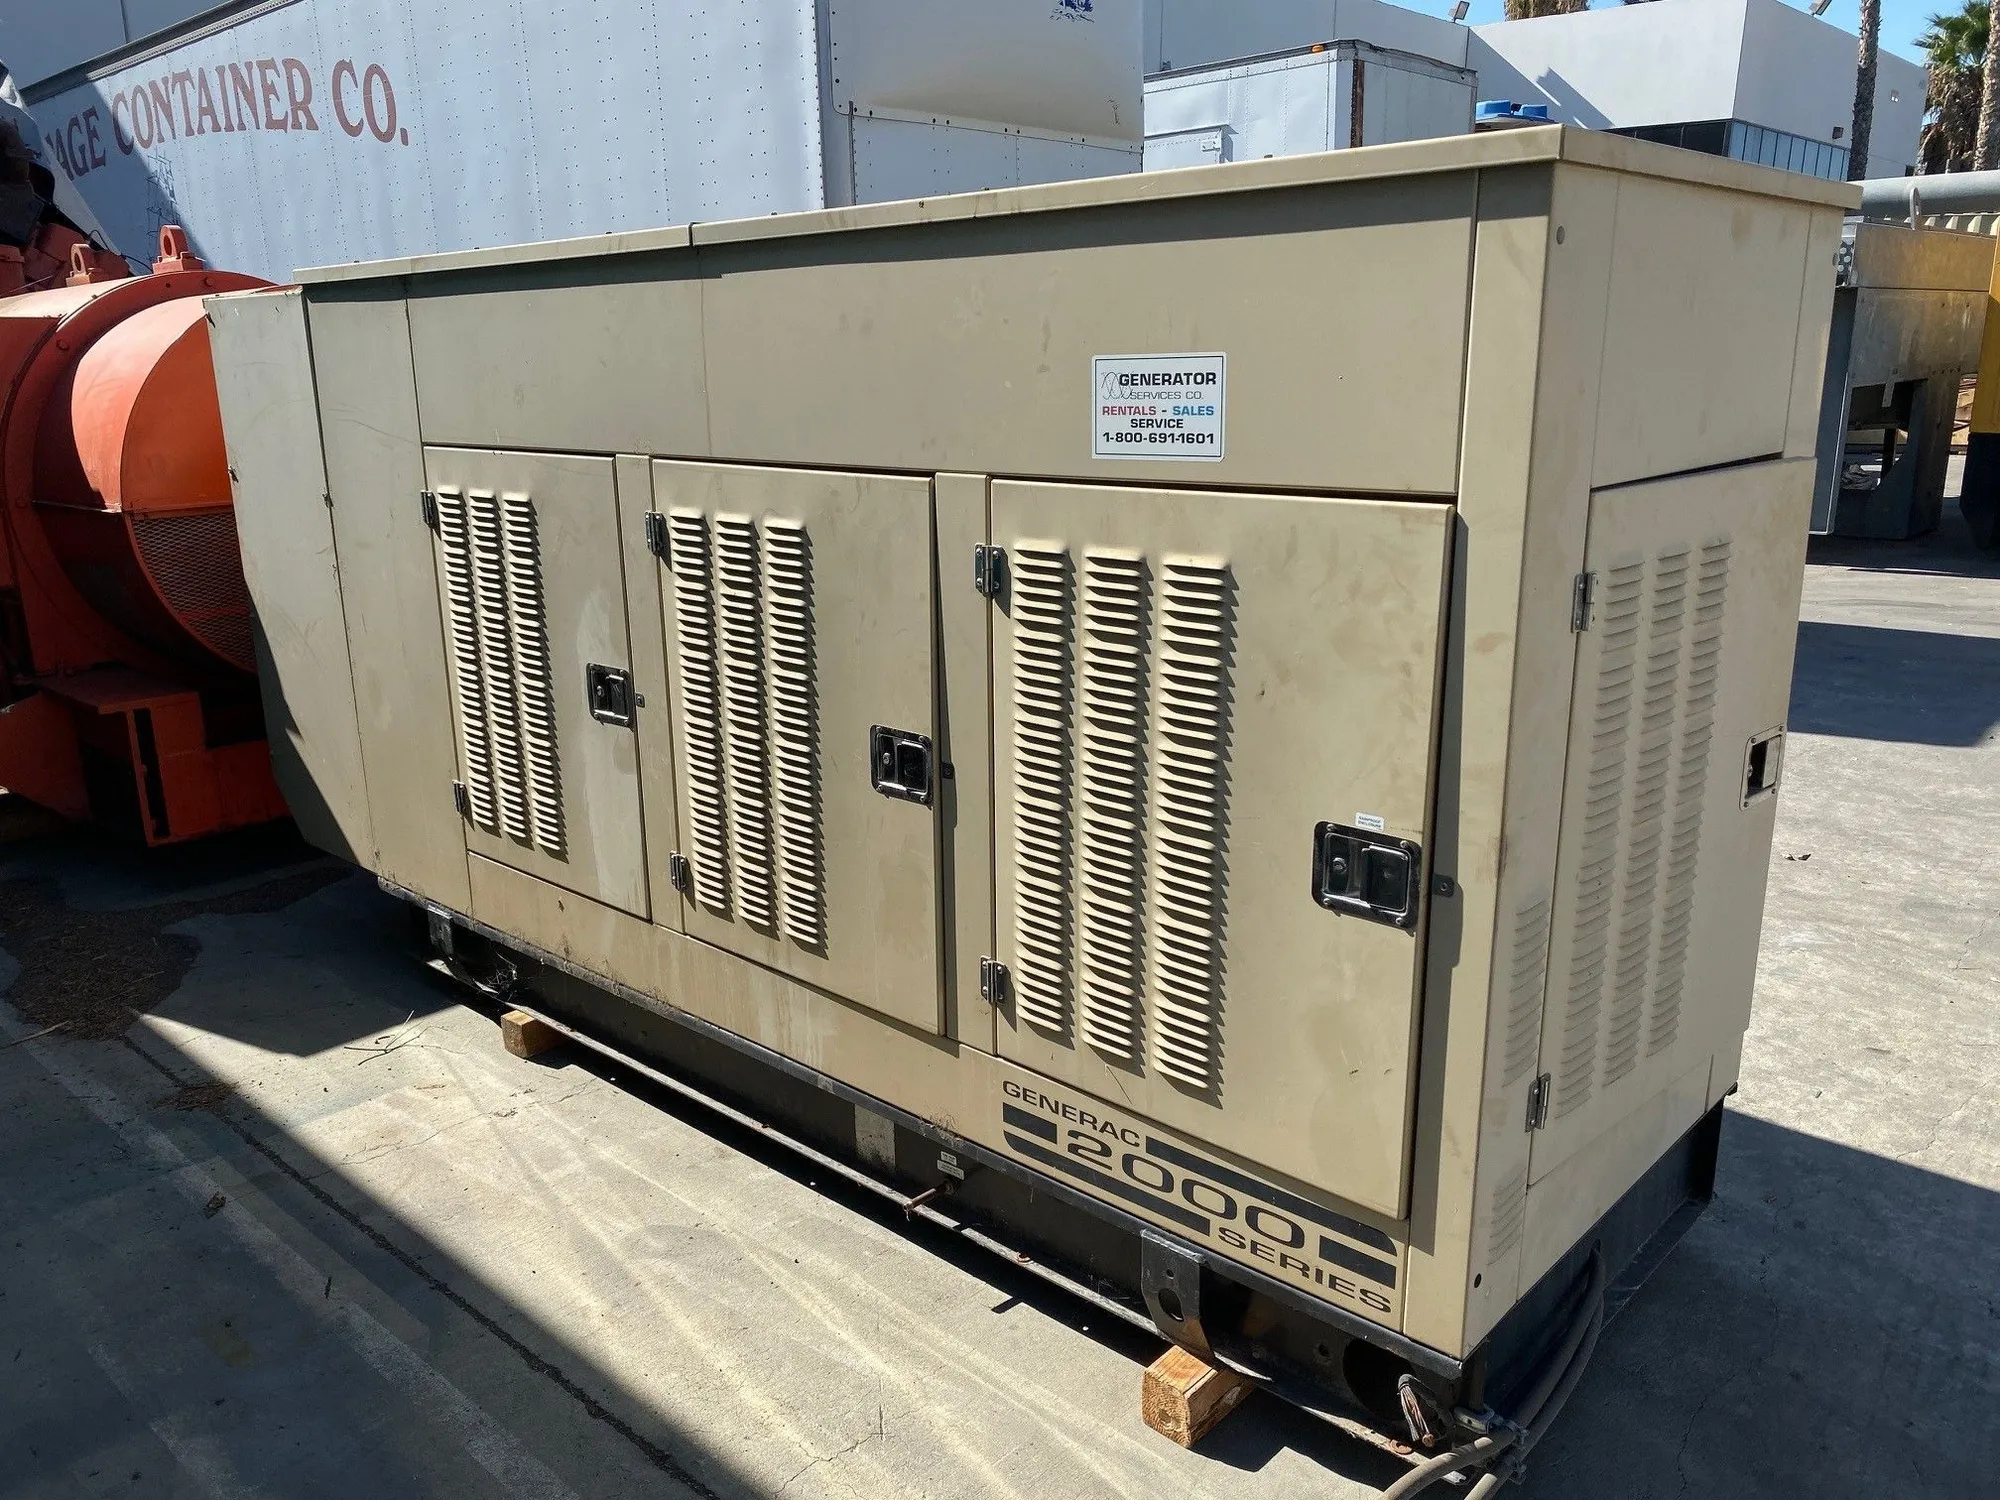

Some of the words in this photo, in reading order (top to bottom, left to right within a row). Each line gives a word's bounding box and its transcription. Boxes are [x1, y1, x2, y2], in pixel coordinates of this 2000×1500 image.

[45, 105, 107, 181] AGE
[112, 57, 319, 155] CONTAINER
[331, 59, 409, 146] CO.
[1119, 372, 1217, 386] GENERATOR
[1130, 391, 1181, 400] SERVICES
[1186, 391, 1203, 400] CO.
[1102, 406, 1157, 416] RENTALS
[1172, 406, 1214, 416] SALES
[1130, 418, 1184, 429] SERVICE
[1102, 432, 1214, 444] 1-800-691-1601
[1002, 1080, 1141, 1148] GENERAC
[1066, 1129, 1305, 1250] 2000
[1218, 1226, 1392, 1314] SERIES
